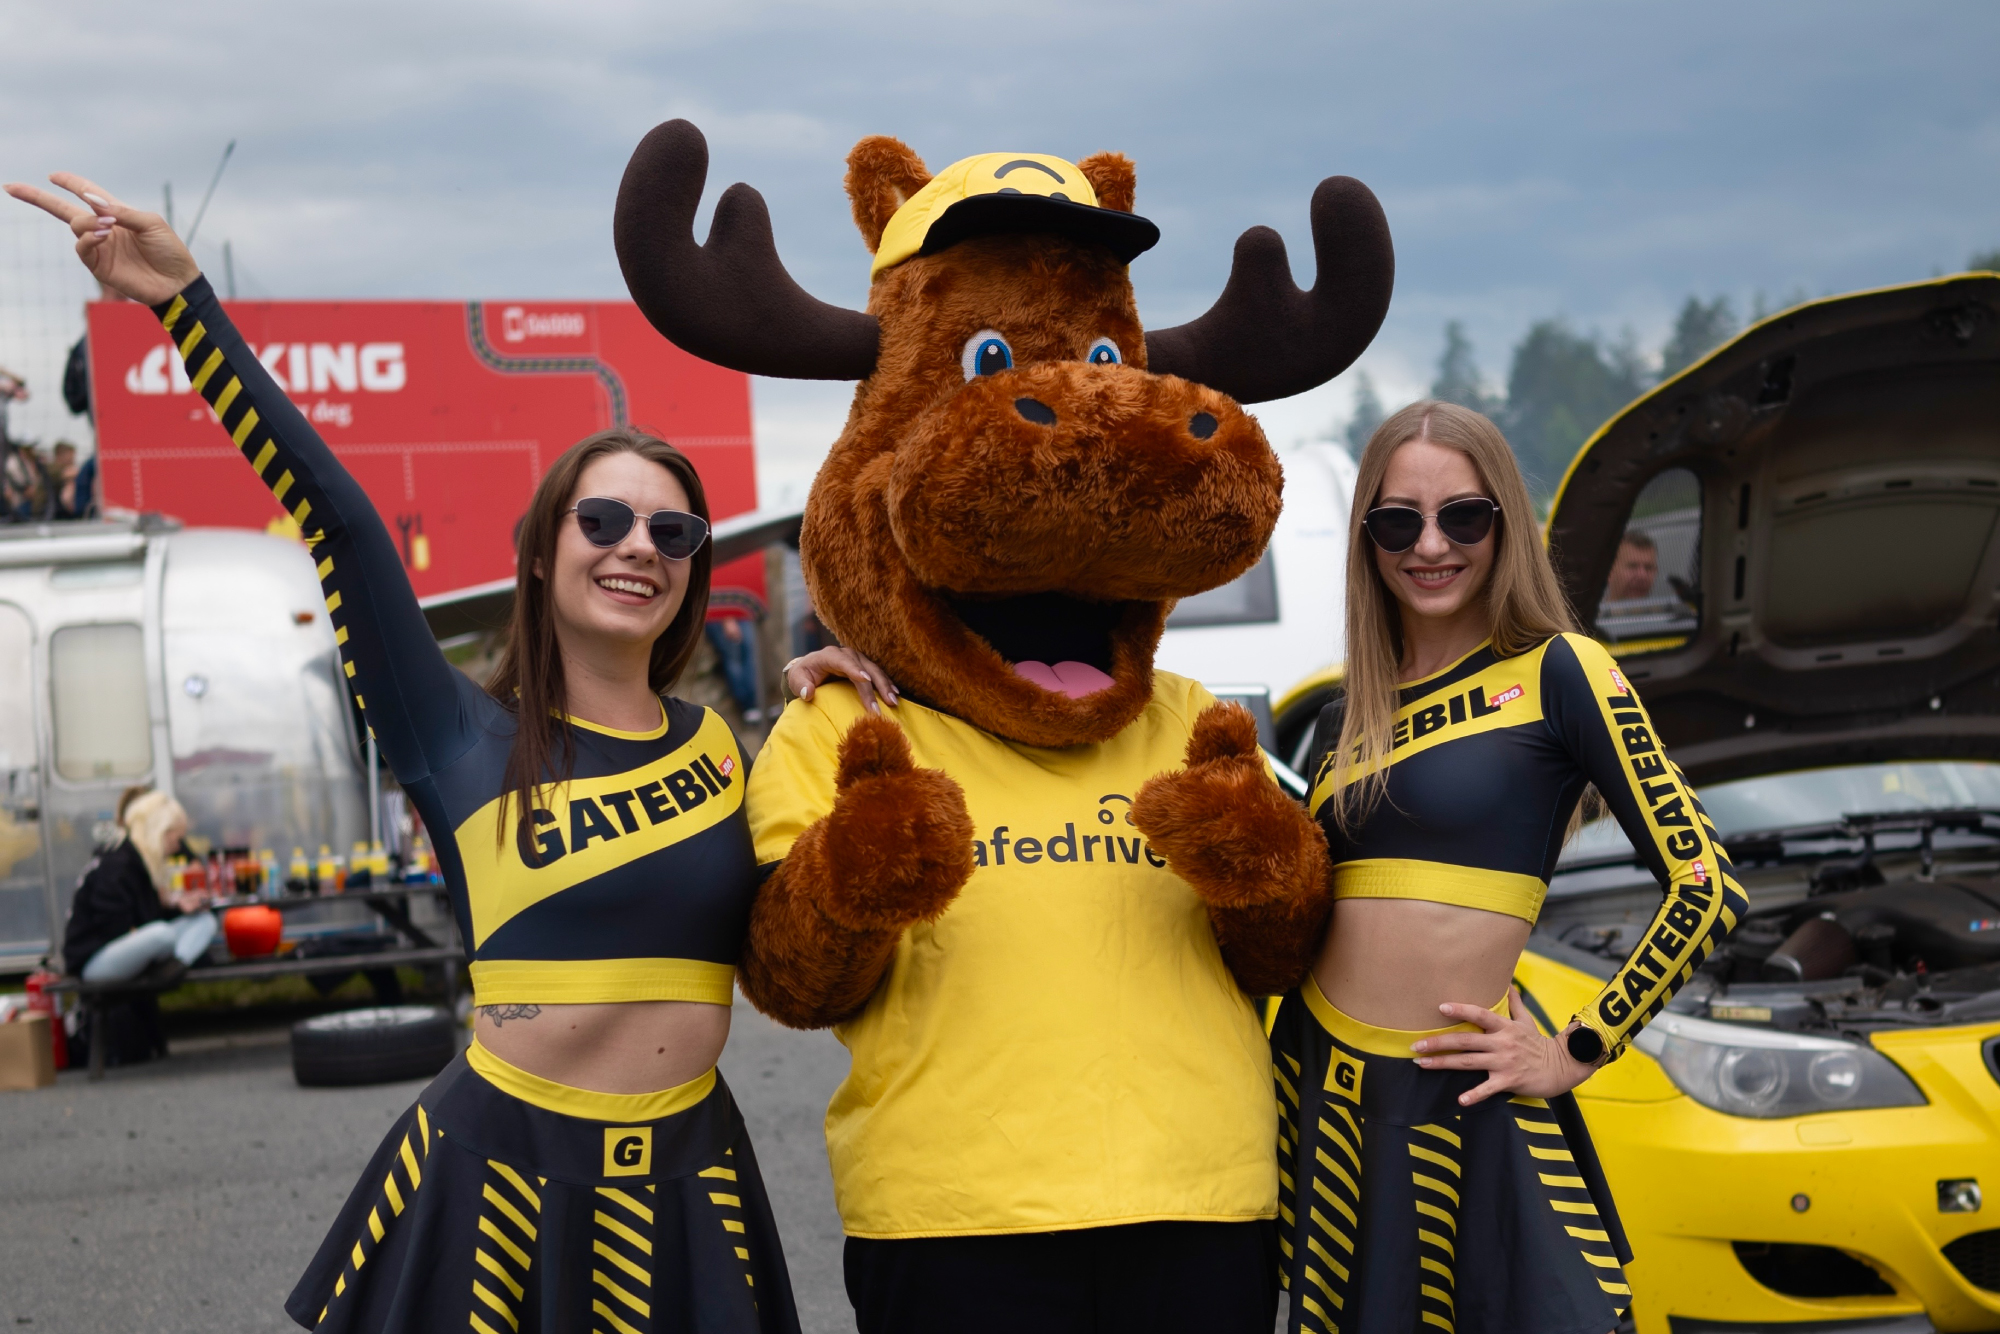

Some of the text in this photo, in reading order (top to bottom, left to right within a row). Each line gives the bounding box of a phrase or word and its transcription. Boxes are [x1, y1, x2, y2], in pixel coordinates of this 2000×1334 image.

[246, 342, 406, 393] KING
[972, 822, 1167, 868] afedriv
[1334, 1061, 1356, 1093] G
[613, 1135, 644, 1168] G
